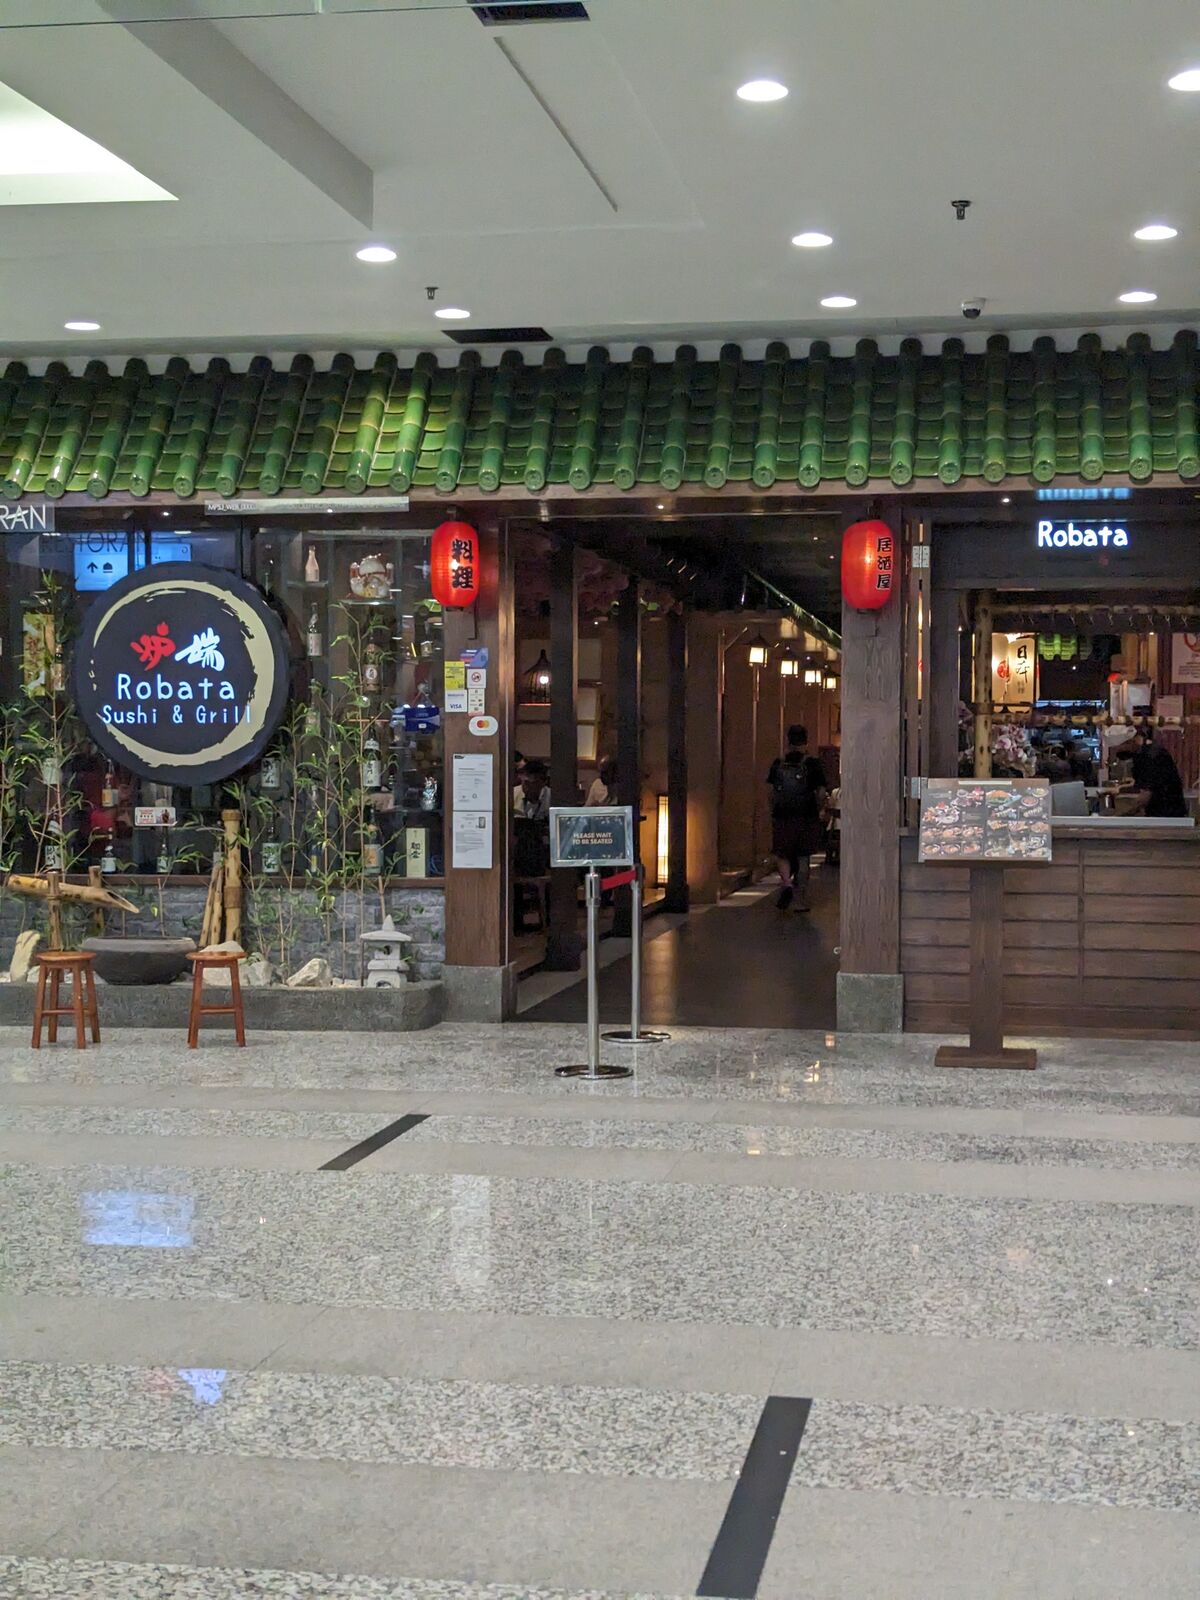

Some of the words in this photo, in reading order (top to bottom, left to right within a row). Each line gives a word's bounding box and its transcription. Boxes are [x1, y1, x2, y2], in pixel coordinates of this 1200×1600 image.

[1038, 520, 1128, 547] Robata
[452, 539, 474, 589] 料理
[877, 537, 892, 589] 居酒屋
[117, 673, 235, 700] Robata
[102, 704, 157, 724] Sushi
[172, 704, 183, 724] &
[196, 704, 251, 724] Grill
